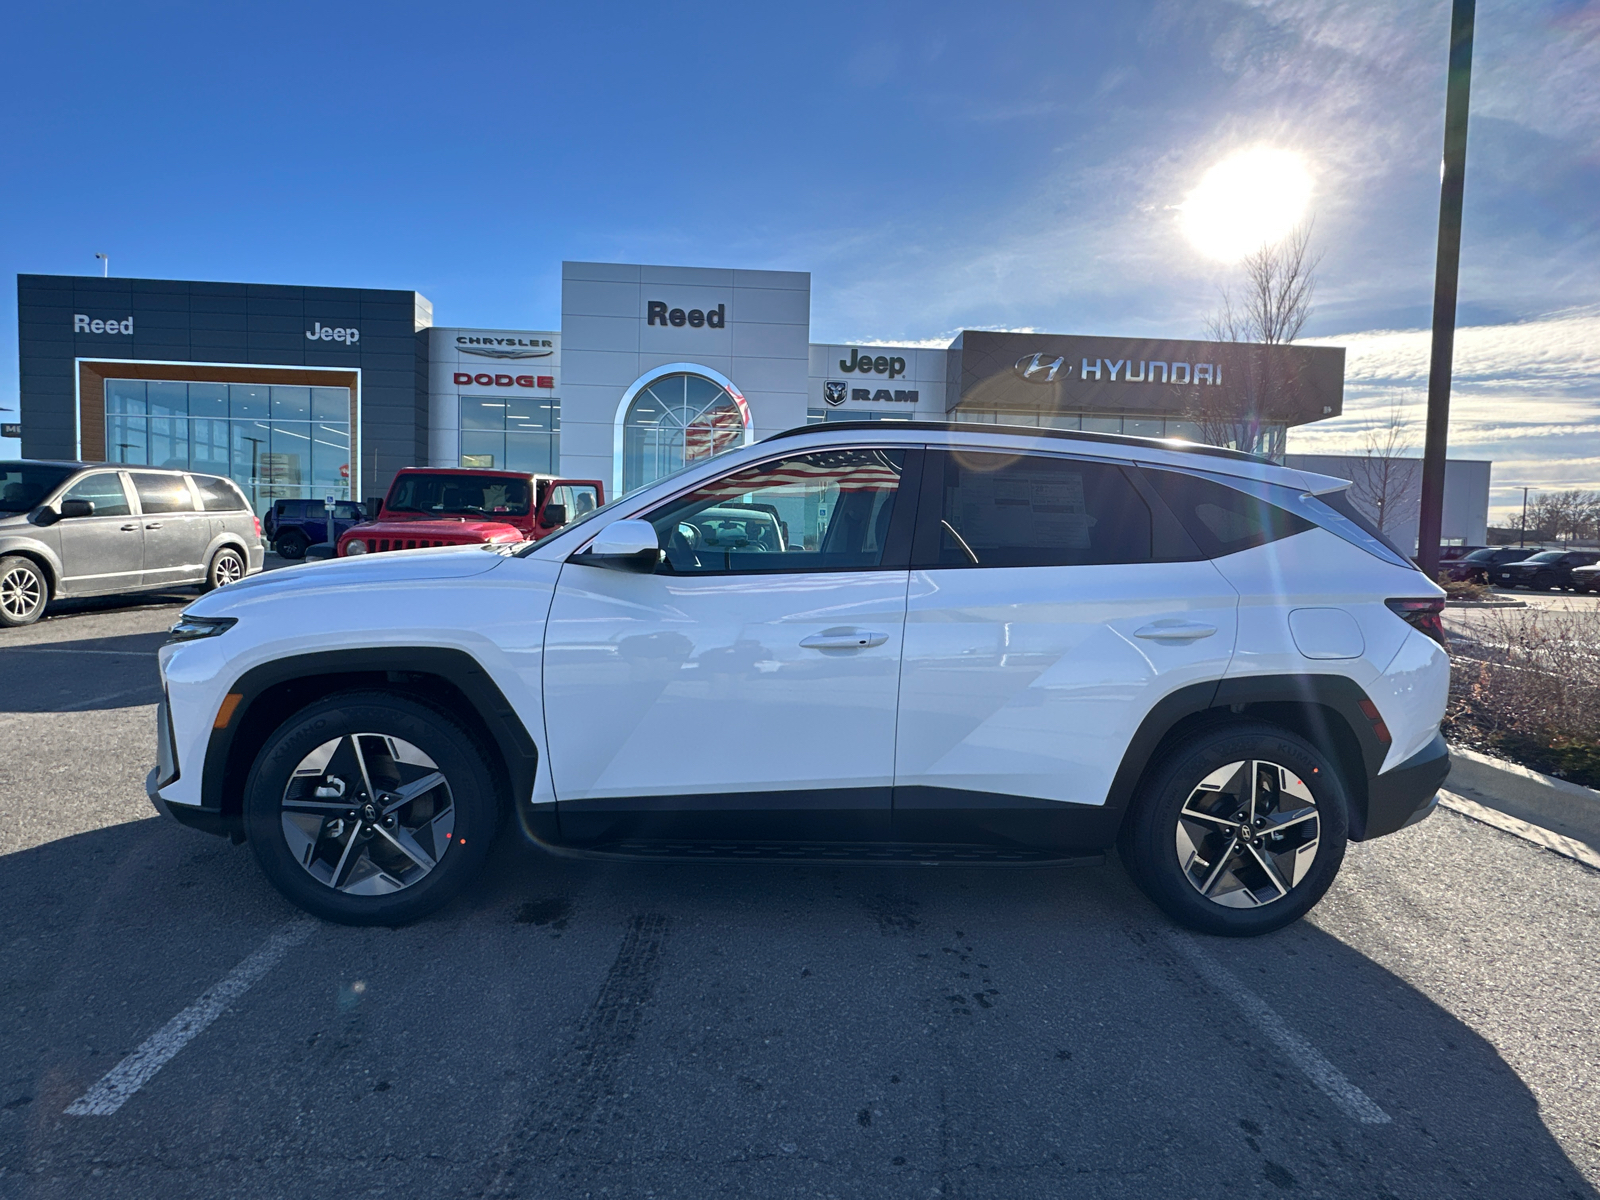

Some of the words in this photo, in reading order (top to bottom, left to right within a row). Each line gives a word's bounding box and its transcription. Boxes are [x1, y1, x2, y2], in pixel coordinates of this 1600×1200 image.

[74, 314, 133, 336] Reed
[647, 300, 725, 328] Reed
[306, 322, 360, 345] Jeep
[456, 336, 553, 347] CHRYSLER
[839, 348, 906, 379] Jeep
[1081, 357, 1222, 386] HYUNDAI
[453, 372, 555, 389] DODGE
[851, 388, 919, 402] RAM
[272, 719, 326, 764] KUMHO
